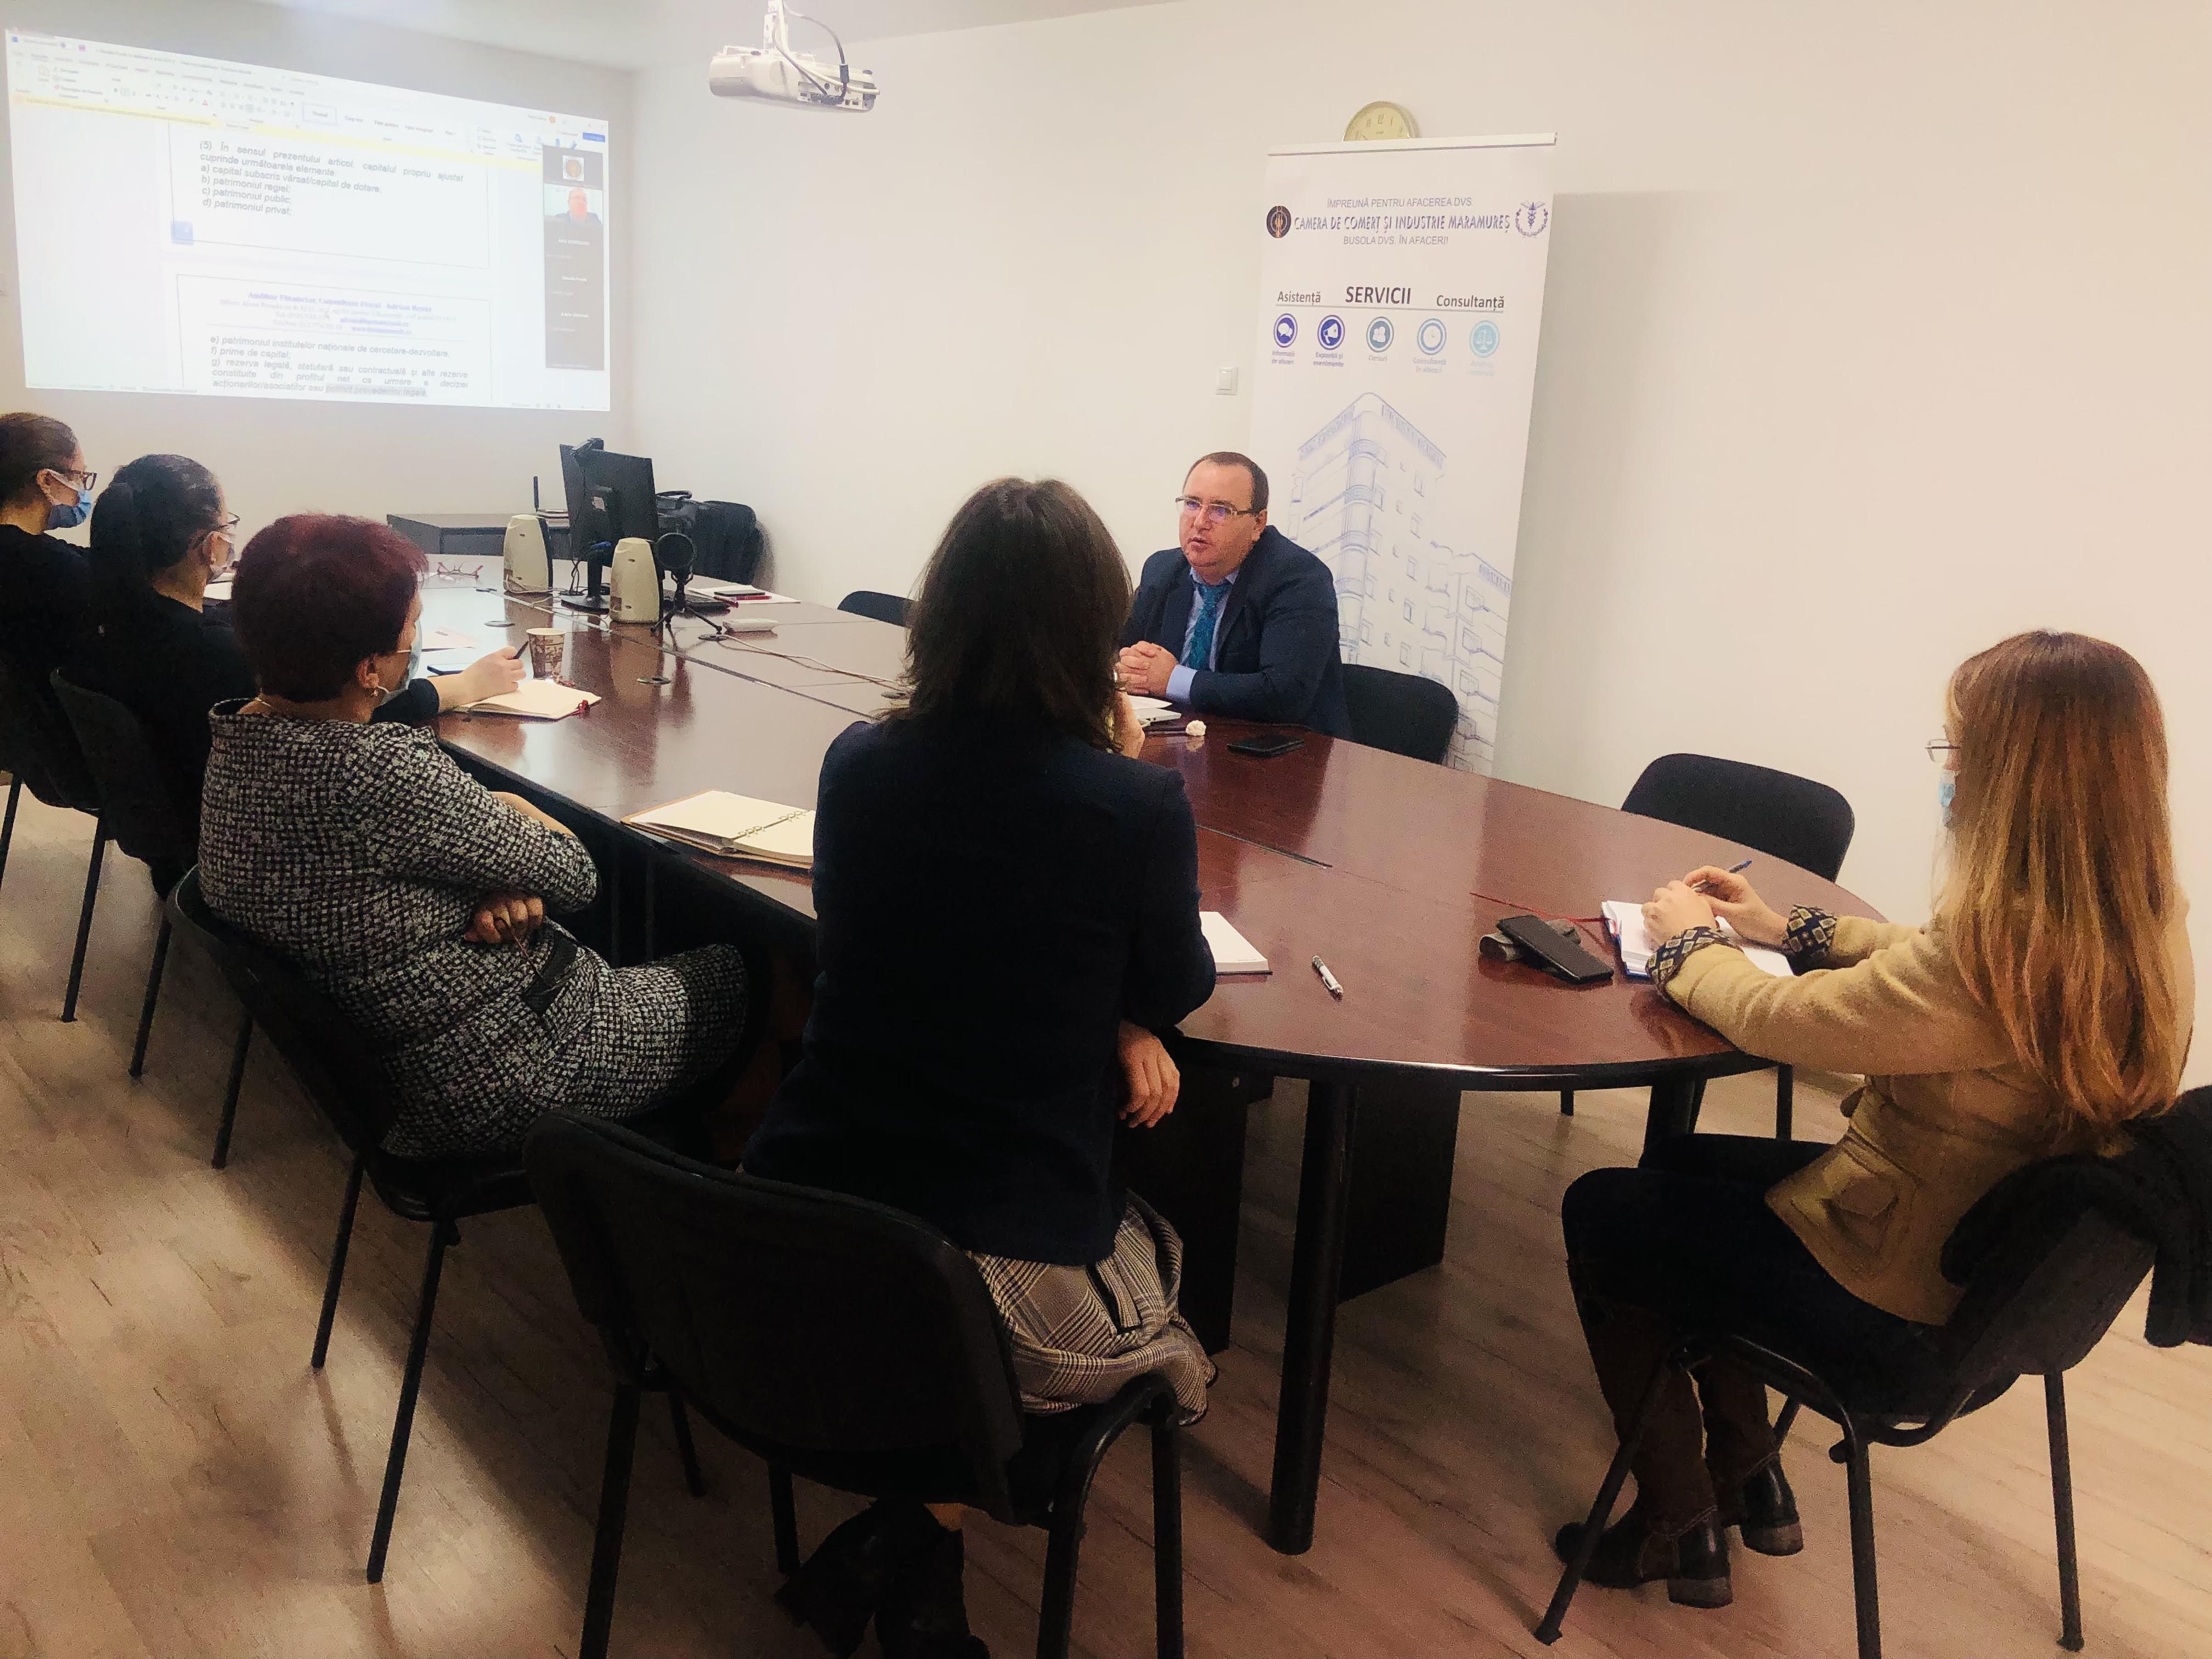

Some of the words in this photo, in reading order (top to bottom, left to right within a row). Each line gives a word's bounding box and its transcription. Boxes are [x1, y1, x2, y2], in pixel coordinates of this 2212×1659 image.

[199, 140, 212, 150] (5)
[221, 141, 229, 151] În
[236, 146, 266, 156] sensul
[273, 151, 320, 163] prezentului
[363, 162, 397, 173] capitalul
[403, 167, 431, 178] propriu
[437, 172, 464, 182] ajustat
[200, 153, 239, 165] cuprinde
[241, 158, 293, 171] următoarele
[201, 165, 210, 173] a)
[212, 166, 241, 177] capital
[244, 170, 280, 180] subscris
[341, 180, 351, 189] de
[201, 175, 210, 184] b)
[213, 178, 262, 189] patrimoniul
[202, 187, 211, 196] c)
[213, 189, 262, 200] patrimoniul
[202, 199, 211, 207] d)
[214, 201, 263, 212] patrimoniul
[1327, 198, 1369, 208] ÎMPREUNĂ
[1372, 198, 1405, 207] PENTRU
[1406, 198, 1452, 207] AFACEREA
[1294, 216, 1327, 230] CAMERA
[1330, 217, 1341, 229] DE
[1395, 215, 1446, 229] INDUSTRIE
[1448, 215, 1510, 233] MARAMUREȘ
[1343, 236, 1376, 245] BUSOLA
[1378, 236, 1396, 245] DVS.
[1399, 234, 1408, 245] ÎN
[1277, 291, 1321, 306] Asistență
[1345, 286, 1411, 304] SERVICII
[1436, 295, 1504, 311] Consultanță
[210, 336, 219, 345] e)
[222, 336, 270, 347] patrimoniul
[272, 339, 315, 349] institutelor
[210, 346, 217, 356] f)
[219, 348, 244, 357] prime
[247, 348, 258, 357] de
[211, 358, 221, 367] g)
[358, 366, 406, 375] contractuală
[421, 369, 436, 377] alte
[212, 369, 257, 378] constituite
[296, 374, 325, 383] profitul
[440, 380, 469, 388] deciziei
